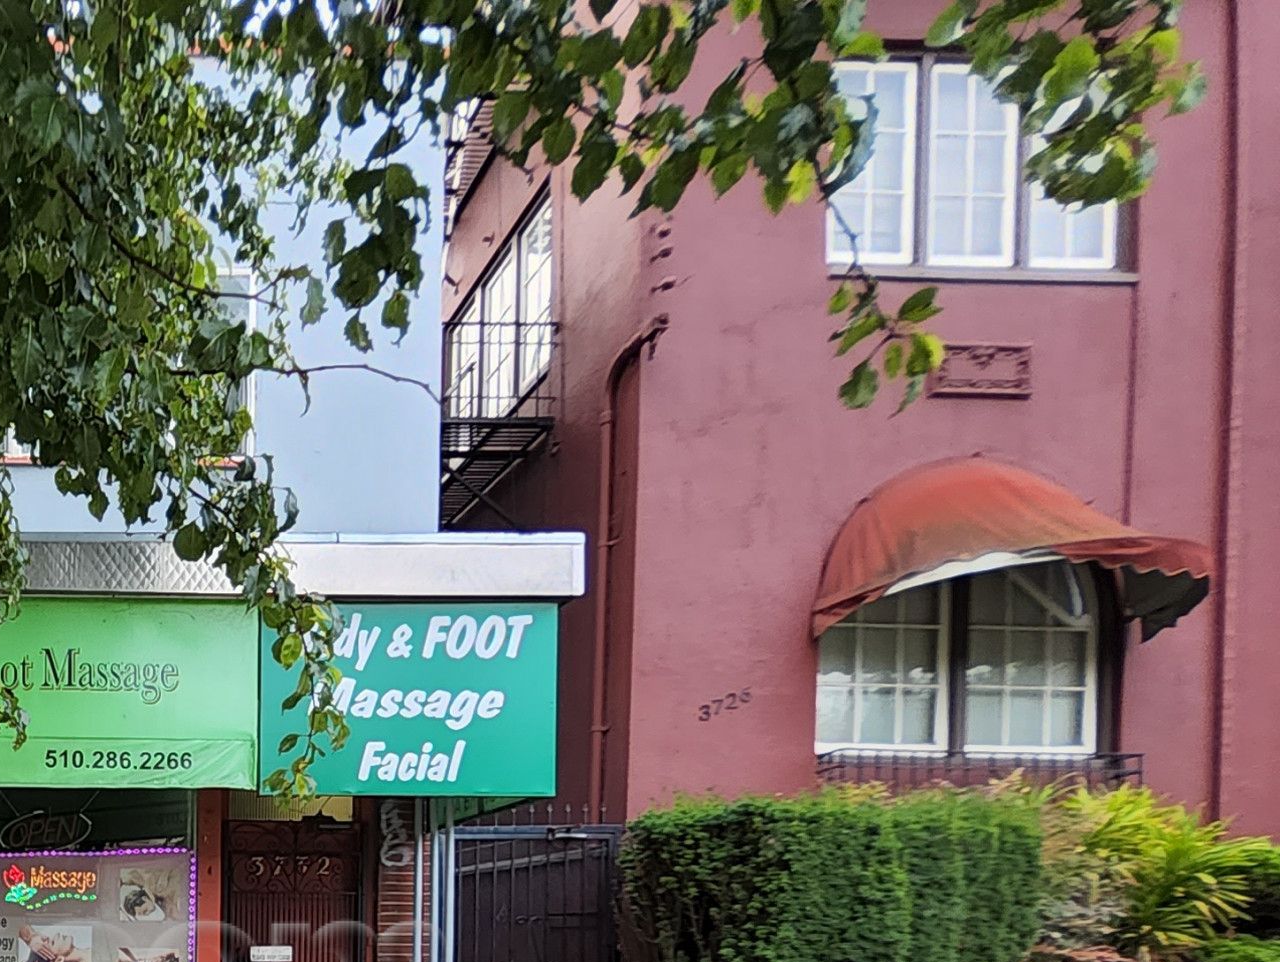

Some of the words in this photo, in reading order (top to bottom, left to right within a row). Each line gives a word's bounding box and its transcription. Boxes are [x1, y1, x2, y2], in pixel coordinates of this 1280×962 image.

[387, 624, 414, 658] &
[422, 614, 534, 659] FOOT
[39, 646, 180, 703] Massage
[44, 750, 193, 770] 510.286.2266
[357, 740, 466, 782] Facial
[9, 815, 79, 847] OPEN
[30, 865, 96, 894] Massage
